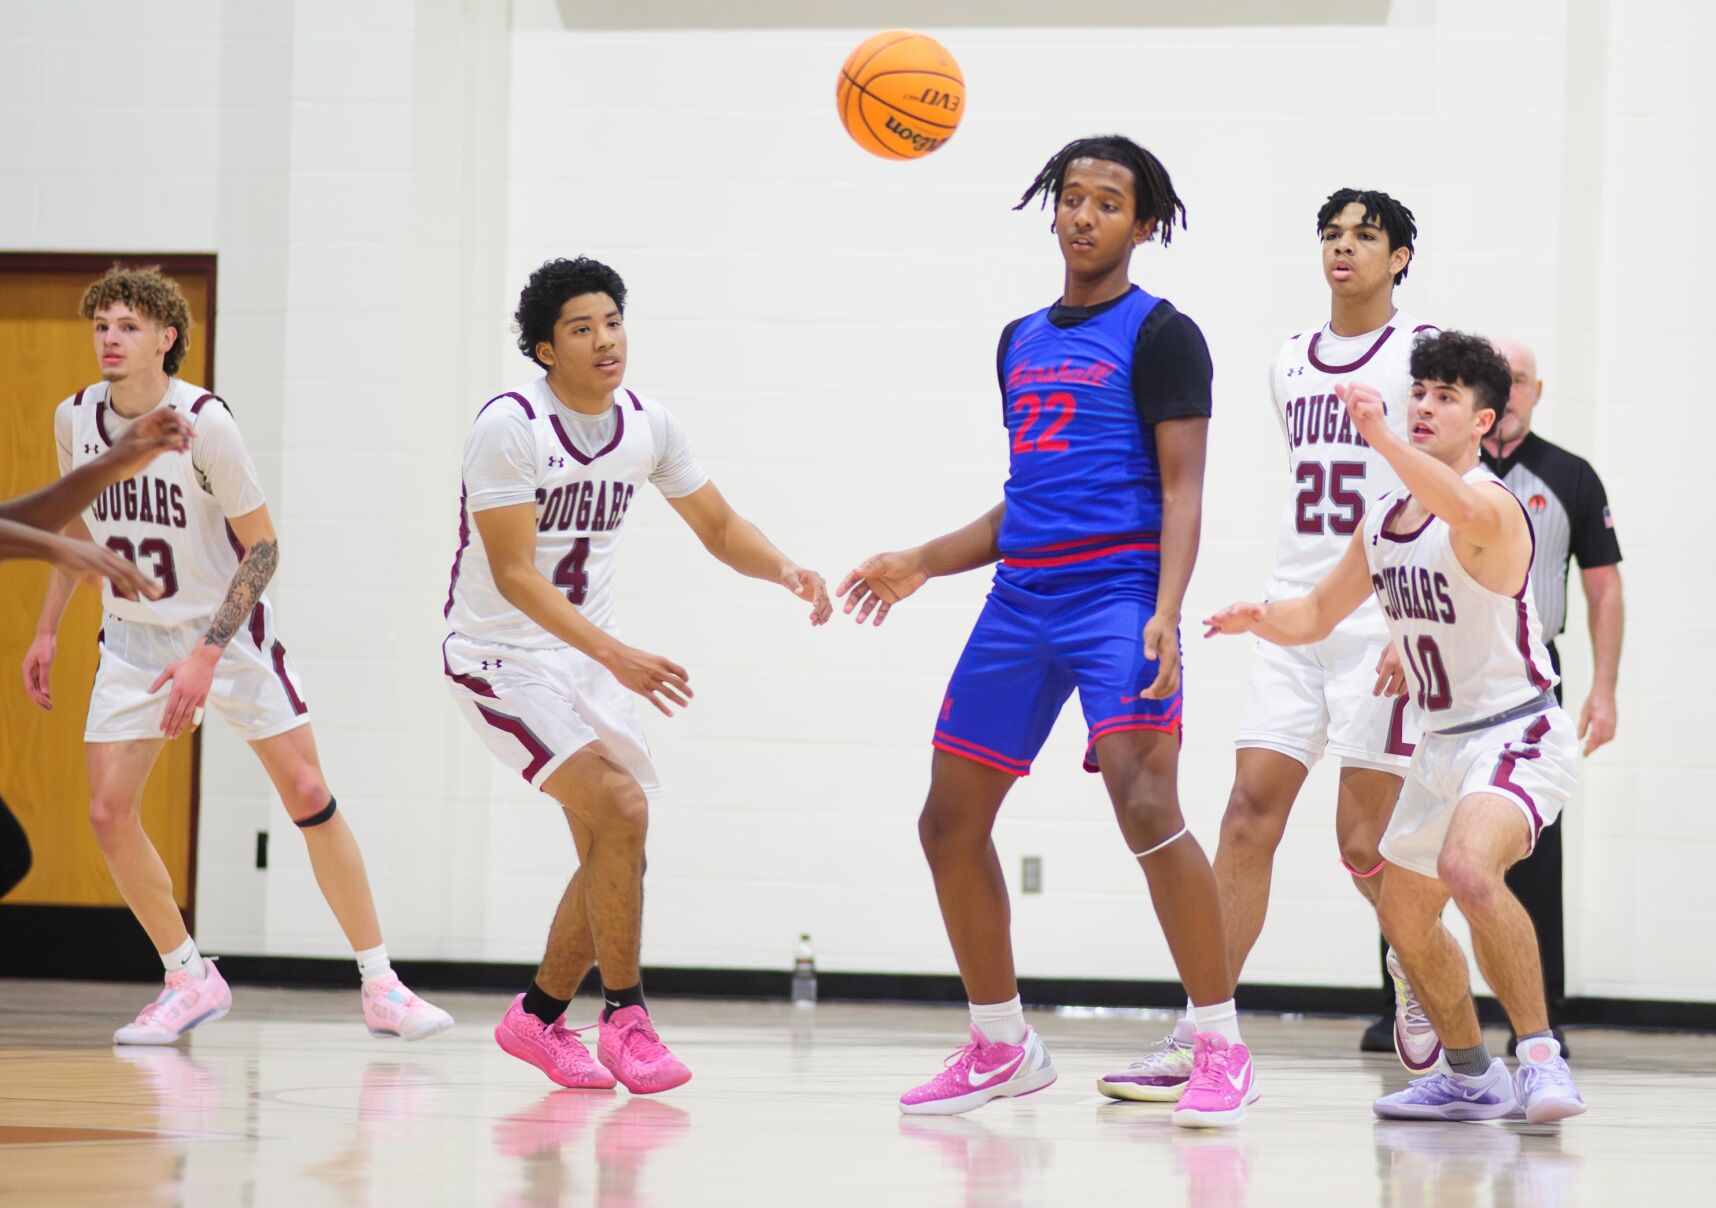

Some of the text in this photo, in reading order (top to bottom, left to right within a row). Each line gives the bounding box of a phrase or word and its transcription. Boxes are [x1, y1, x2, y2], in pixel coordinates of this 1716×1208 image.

[920, 88, 960, 112] EVO
[1013, 391, 1077, 454] 22
[1286, 394, 1387, 452] COUGA
[92, 475, 187, 528] OUGARS
[1295, 460, 1367, 536] 25
[552, 537, 591, 606] 4
[1403, 634, 1454, 712] 10
